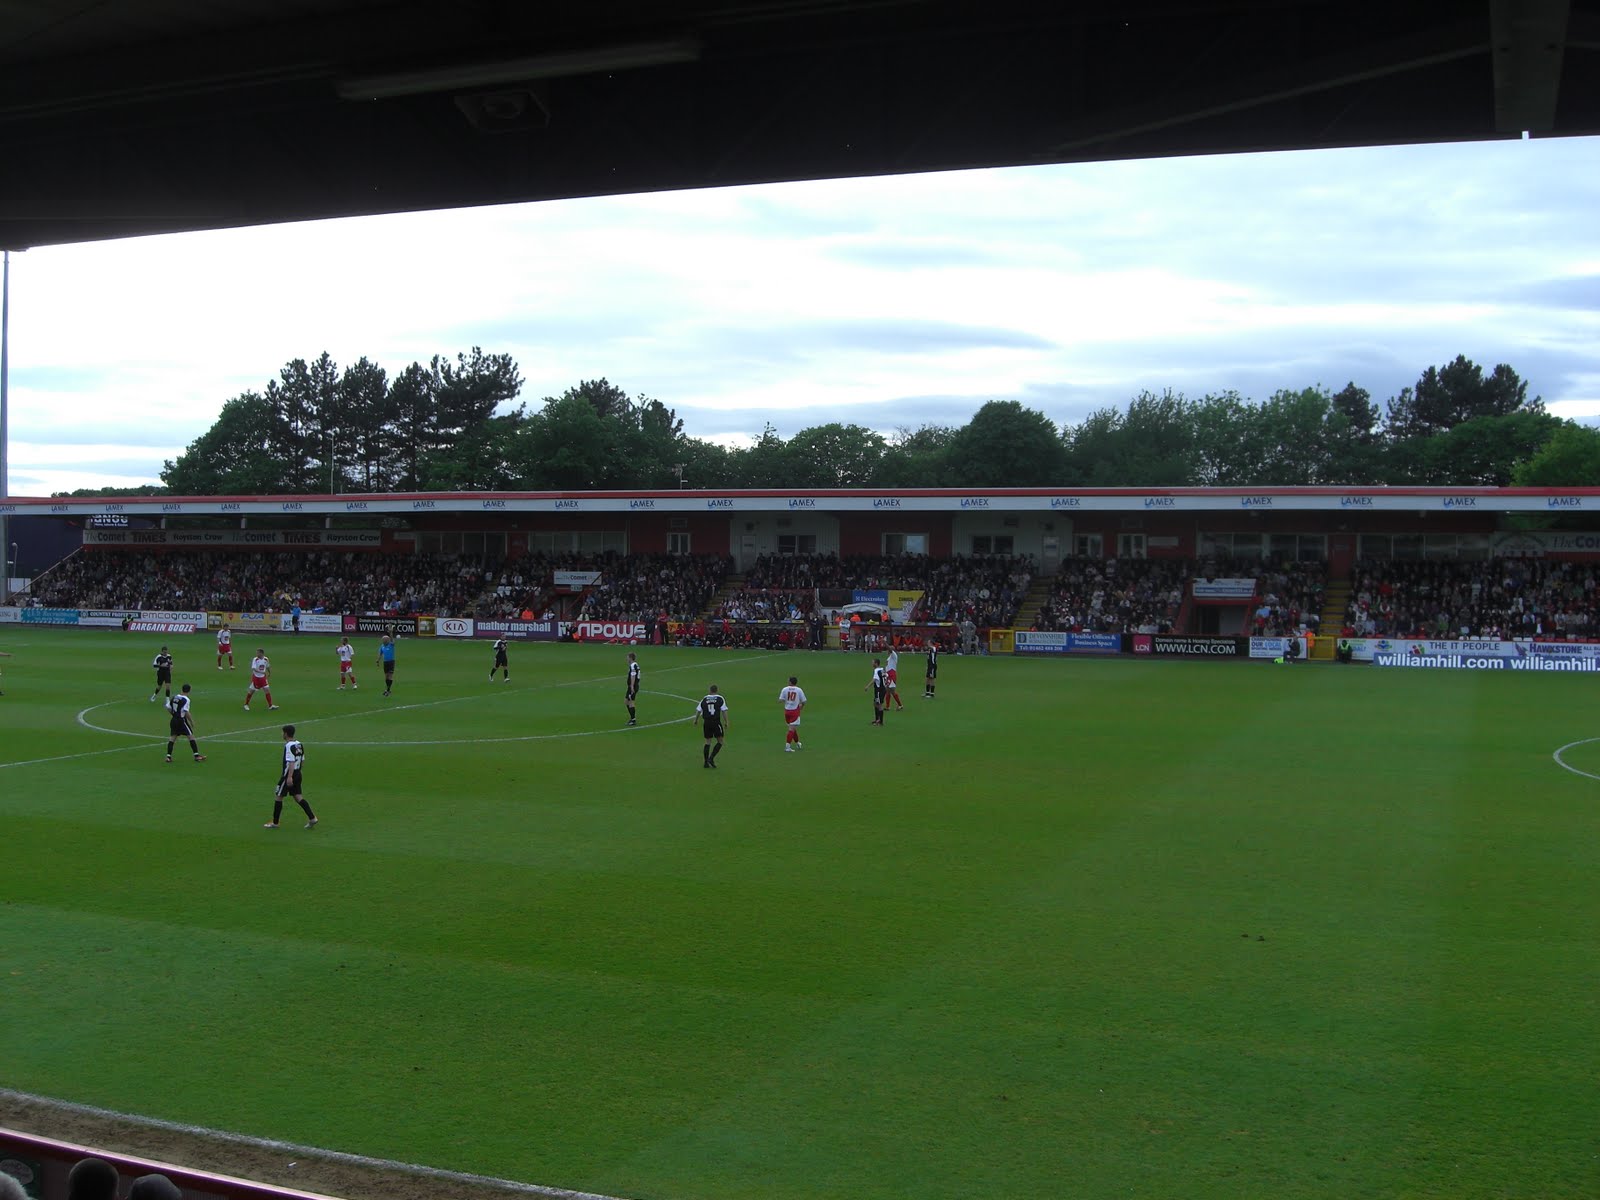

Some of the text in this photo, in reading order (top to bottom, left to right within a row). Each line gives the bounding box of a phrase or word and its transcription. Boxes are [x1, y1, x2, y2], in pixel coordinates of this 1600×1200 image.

[346, 502, 367, 510] LAMEX
[413, 501, 435, 509] LAMEX
[482, 501, 505, 509] LAMEX
[630, 500, 654, 508] LAMEX
[707, 500, 733, 508] LAMEX
[788, 499, 815, 507] LAMEX
[873, 499, 900, 507] LAMEX
[960, 498, 989, 507] LAMEX
[1050, 498, 1080, 507] LAMEX
[1144, 498, 1175, 506] LAMEX
[1241, 497, 1272, 506] LAMEX
[1341, 497, 1373, 506] LAMEX
[1443, 497, 1475, 506] LAMEX
[1548, 497, 1581, 506] LAMEX
[162, 503, 181, 511] LAMEX
[221, 503, 240, 511] LAMEX
[97, 532, 126, 542] Comet
[130, 531, 167, 543] TIMES
[244, 532, 276, 542] Comet
[281, 531, 322, 543] TIMES
[326, 534, 358, 542] Royston
[142, 612, 203, 622] emcogroup
[129, 622, 167, 632] BARGAIN
[167, 623, 195, 633] BOOZE
[445, 623, 464, 631] KIA
[477, 621, 510, 631] mather
[510, 622, 551, 632] marshall
[1098, 640, 1113, 648] Space
[1135, 644, 1150, 652] LCN
[1430, 642, 1500, 651] THE IT PEOPLE
[1529, 643, 1583, 654] HAWKSTONE
[1155, 644, 1236, 655] WWW.LCN.COM
[1378, 653, 1504, 669] williamhill.com
[1510, 655, 1600, 672] williamhill.
[787, 691, 797, 702] 10
[707, 704, 716, 716] 4
